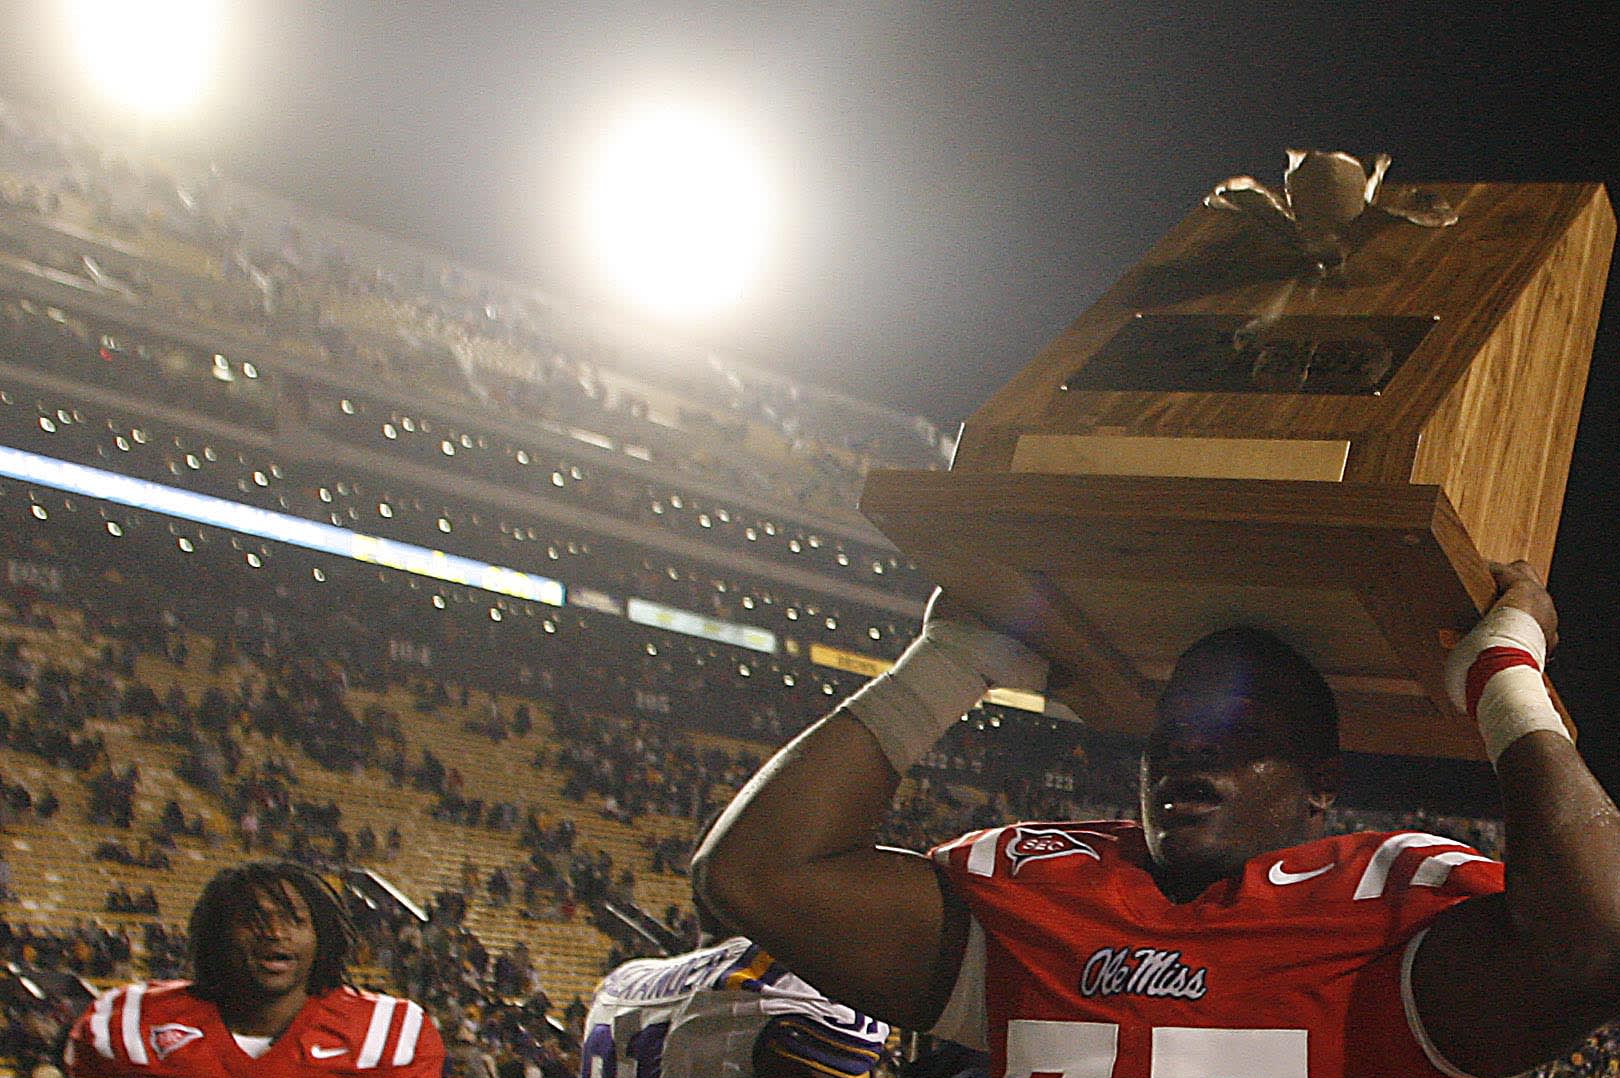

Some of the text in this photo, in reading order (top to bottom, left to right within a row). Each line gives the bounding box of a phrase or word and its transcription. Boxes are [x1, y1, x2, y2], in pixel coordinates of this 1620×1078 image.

[1023, 839, 1064, 851] SEC
[1081, 947, 1207, 999] Ole Miss
